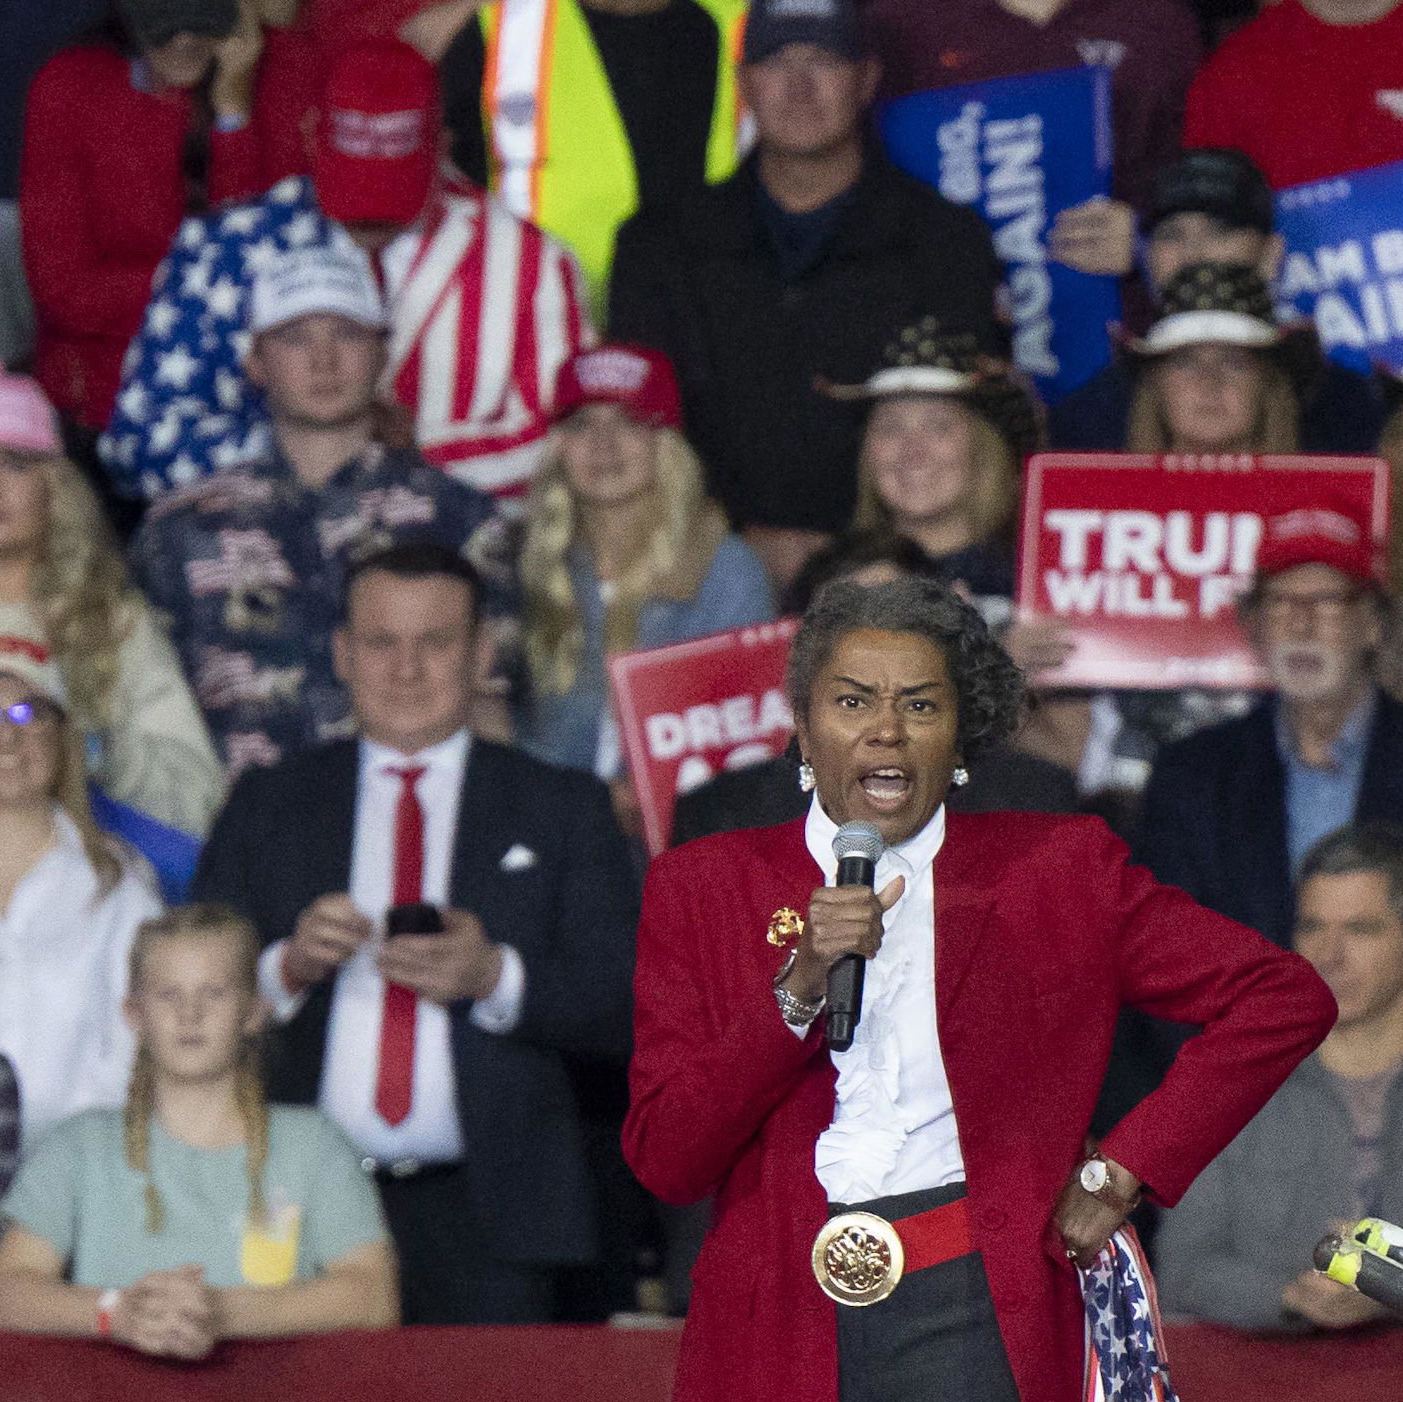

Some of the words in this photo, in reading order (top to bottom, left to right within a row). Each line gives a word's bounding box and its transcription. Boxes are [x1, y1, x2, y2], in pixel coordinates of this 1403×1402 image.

[1278, 239, 1366, 297] AM
[1044, 568, 1190, 618] WILL
[646, 688, 794, 761] DREA
